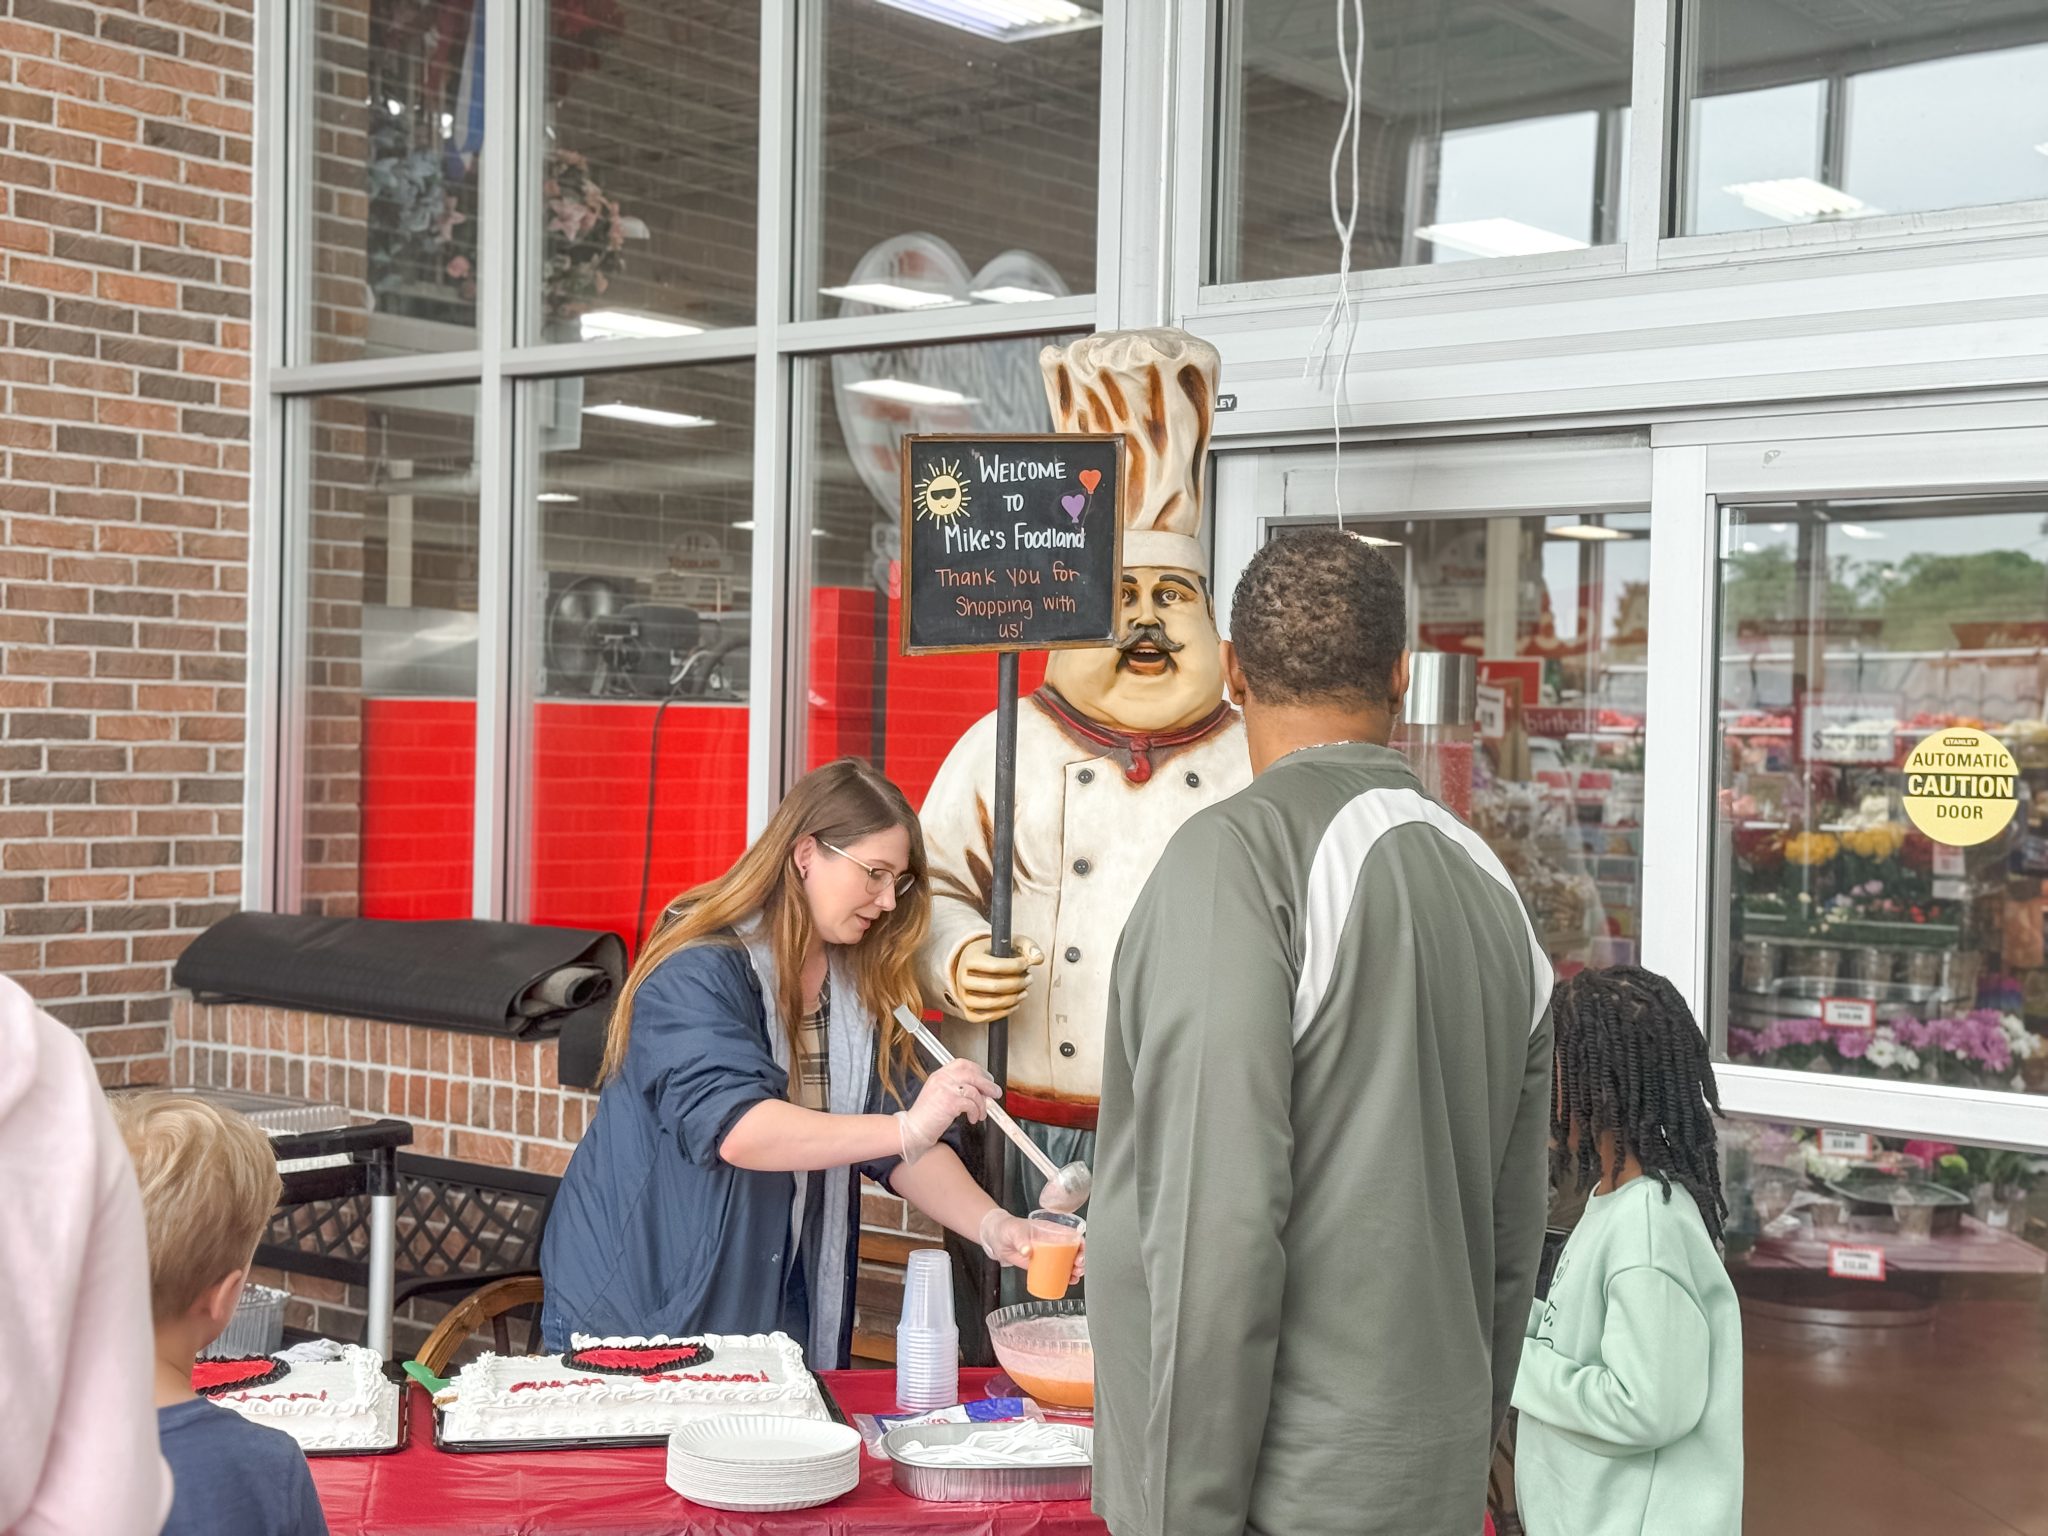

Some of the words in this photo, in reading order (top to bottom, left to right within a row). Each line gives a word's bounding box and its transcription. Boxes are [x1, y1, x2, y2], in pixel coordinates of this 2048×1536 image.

[979, 454, 1067, 483] WELCOME
[1002, 494, 1025, 512] TO
[944, 523, 1007, 554] Mike's
[1014, 522, 1086, 551] Foodland
[935, 567, 997, 588] Thank
[1006, 567, 1041, 587] you
[1052, 560, 1080, 583] for
[955, 595, 1033, 620] Shopping
[1043, 595, 1076, 614] with
[998, 621, 1024, 639] us!
[1912, 752, 2009, 768] AUTOMATIC
[1908, 774, 2014, 798] CAUTION
[1936, 804, 1983, 819] DOOR
